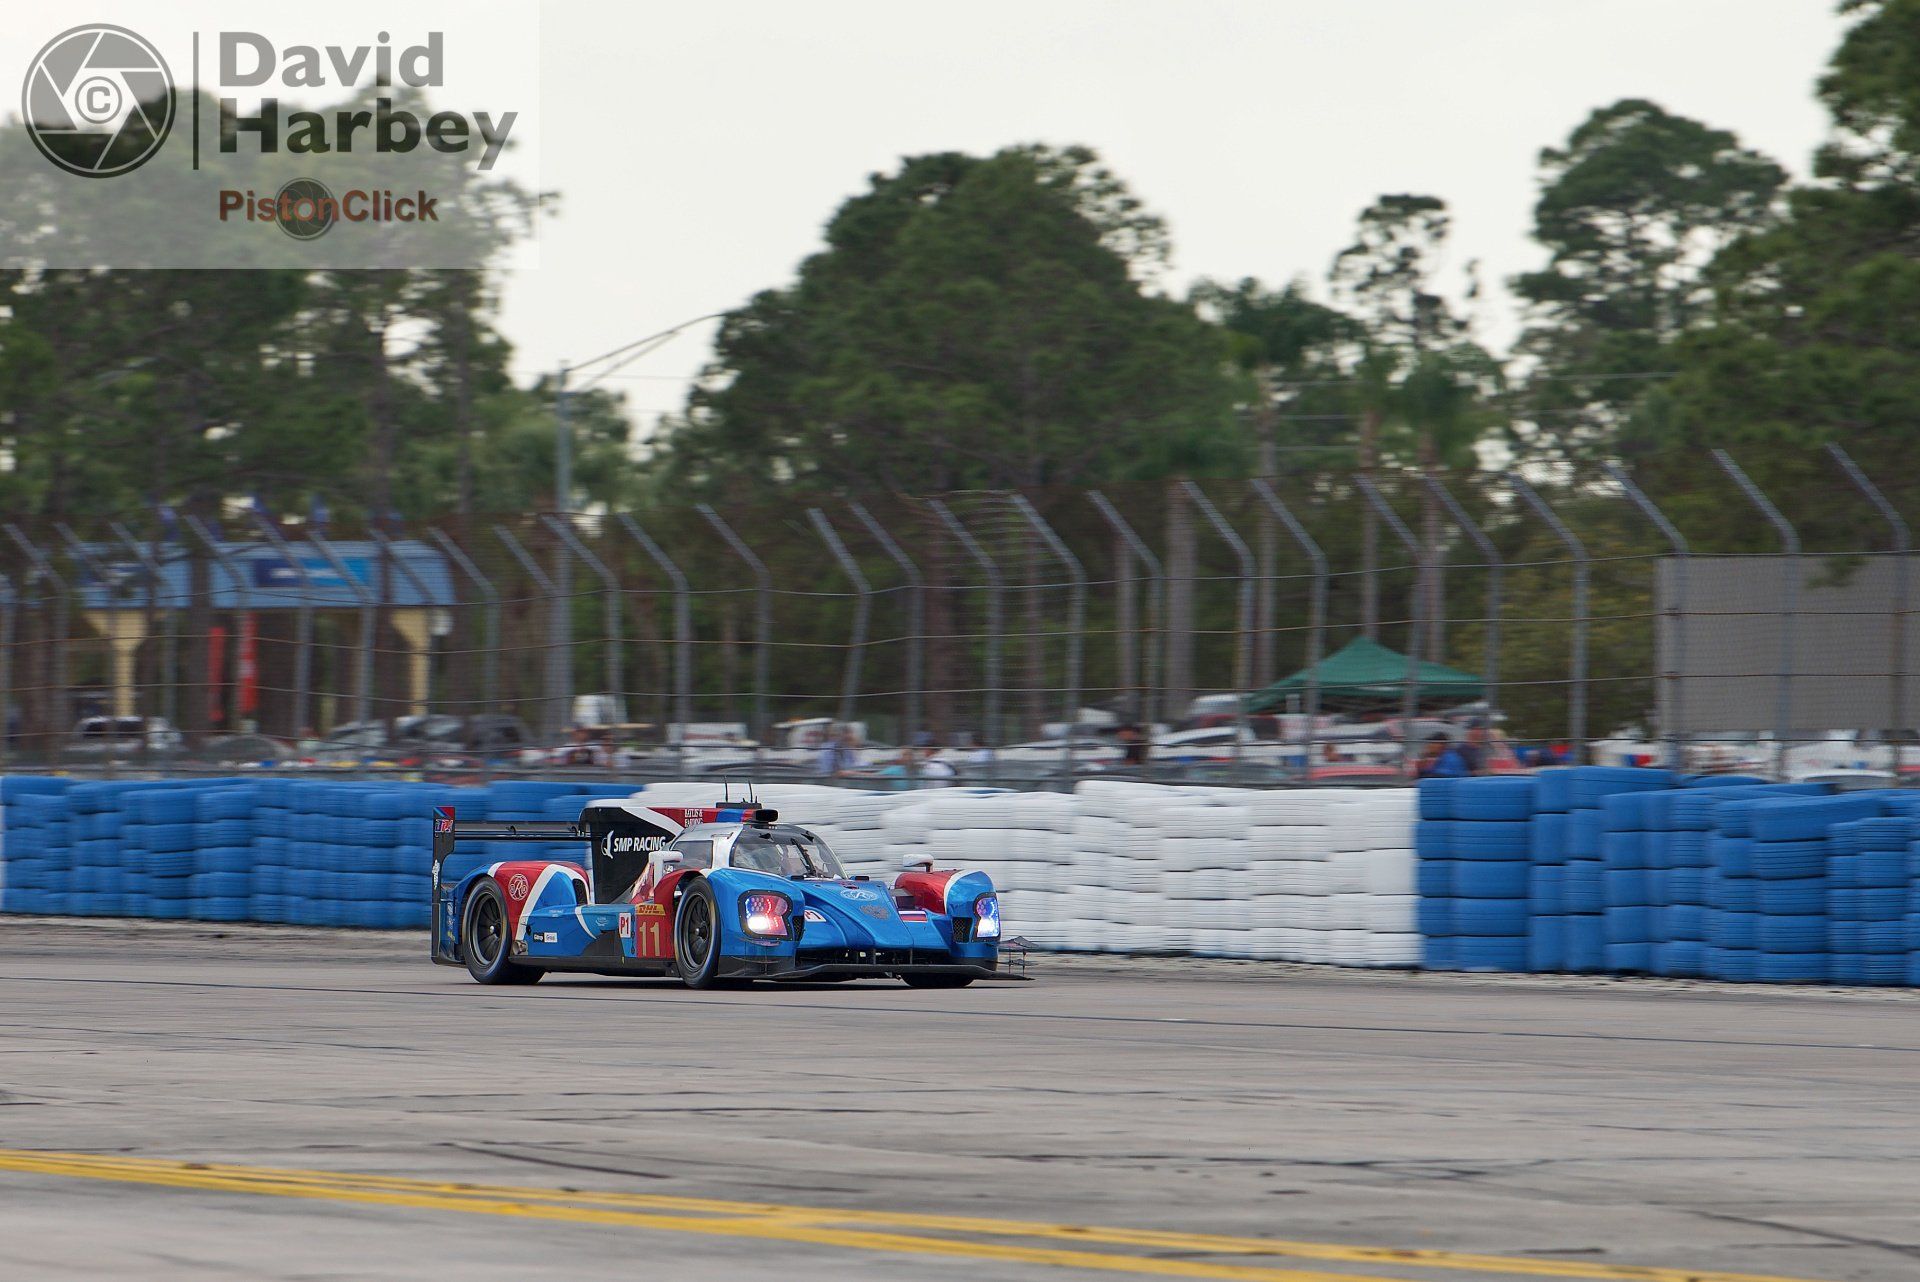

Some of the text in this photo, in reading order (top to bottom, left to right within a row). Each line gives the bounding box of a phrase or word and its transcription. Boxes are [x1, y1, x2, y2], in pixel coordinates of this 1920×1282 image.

[614, 835, 666, 852] SMP RACING
[620, 916, 629, 935] P1
[639, 921, 660, 957] 11
